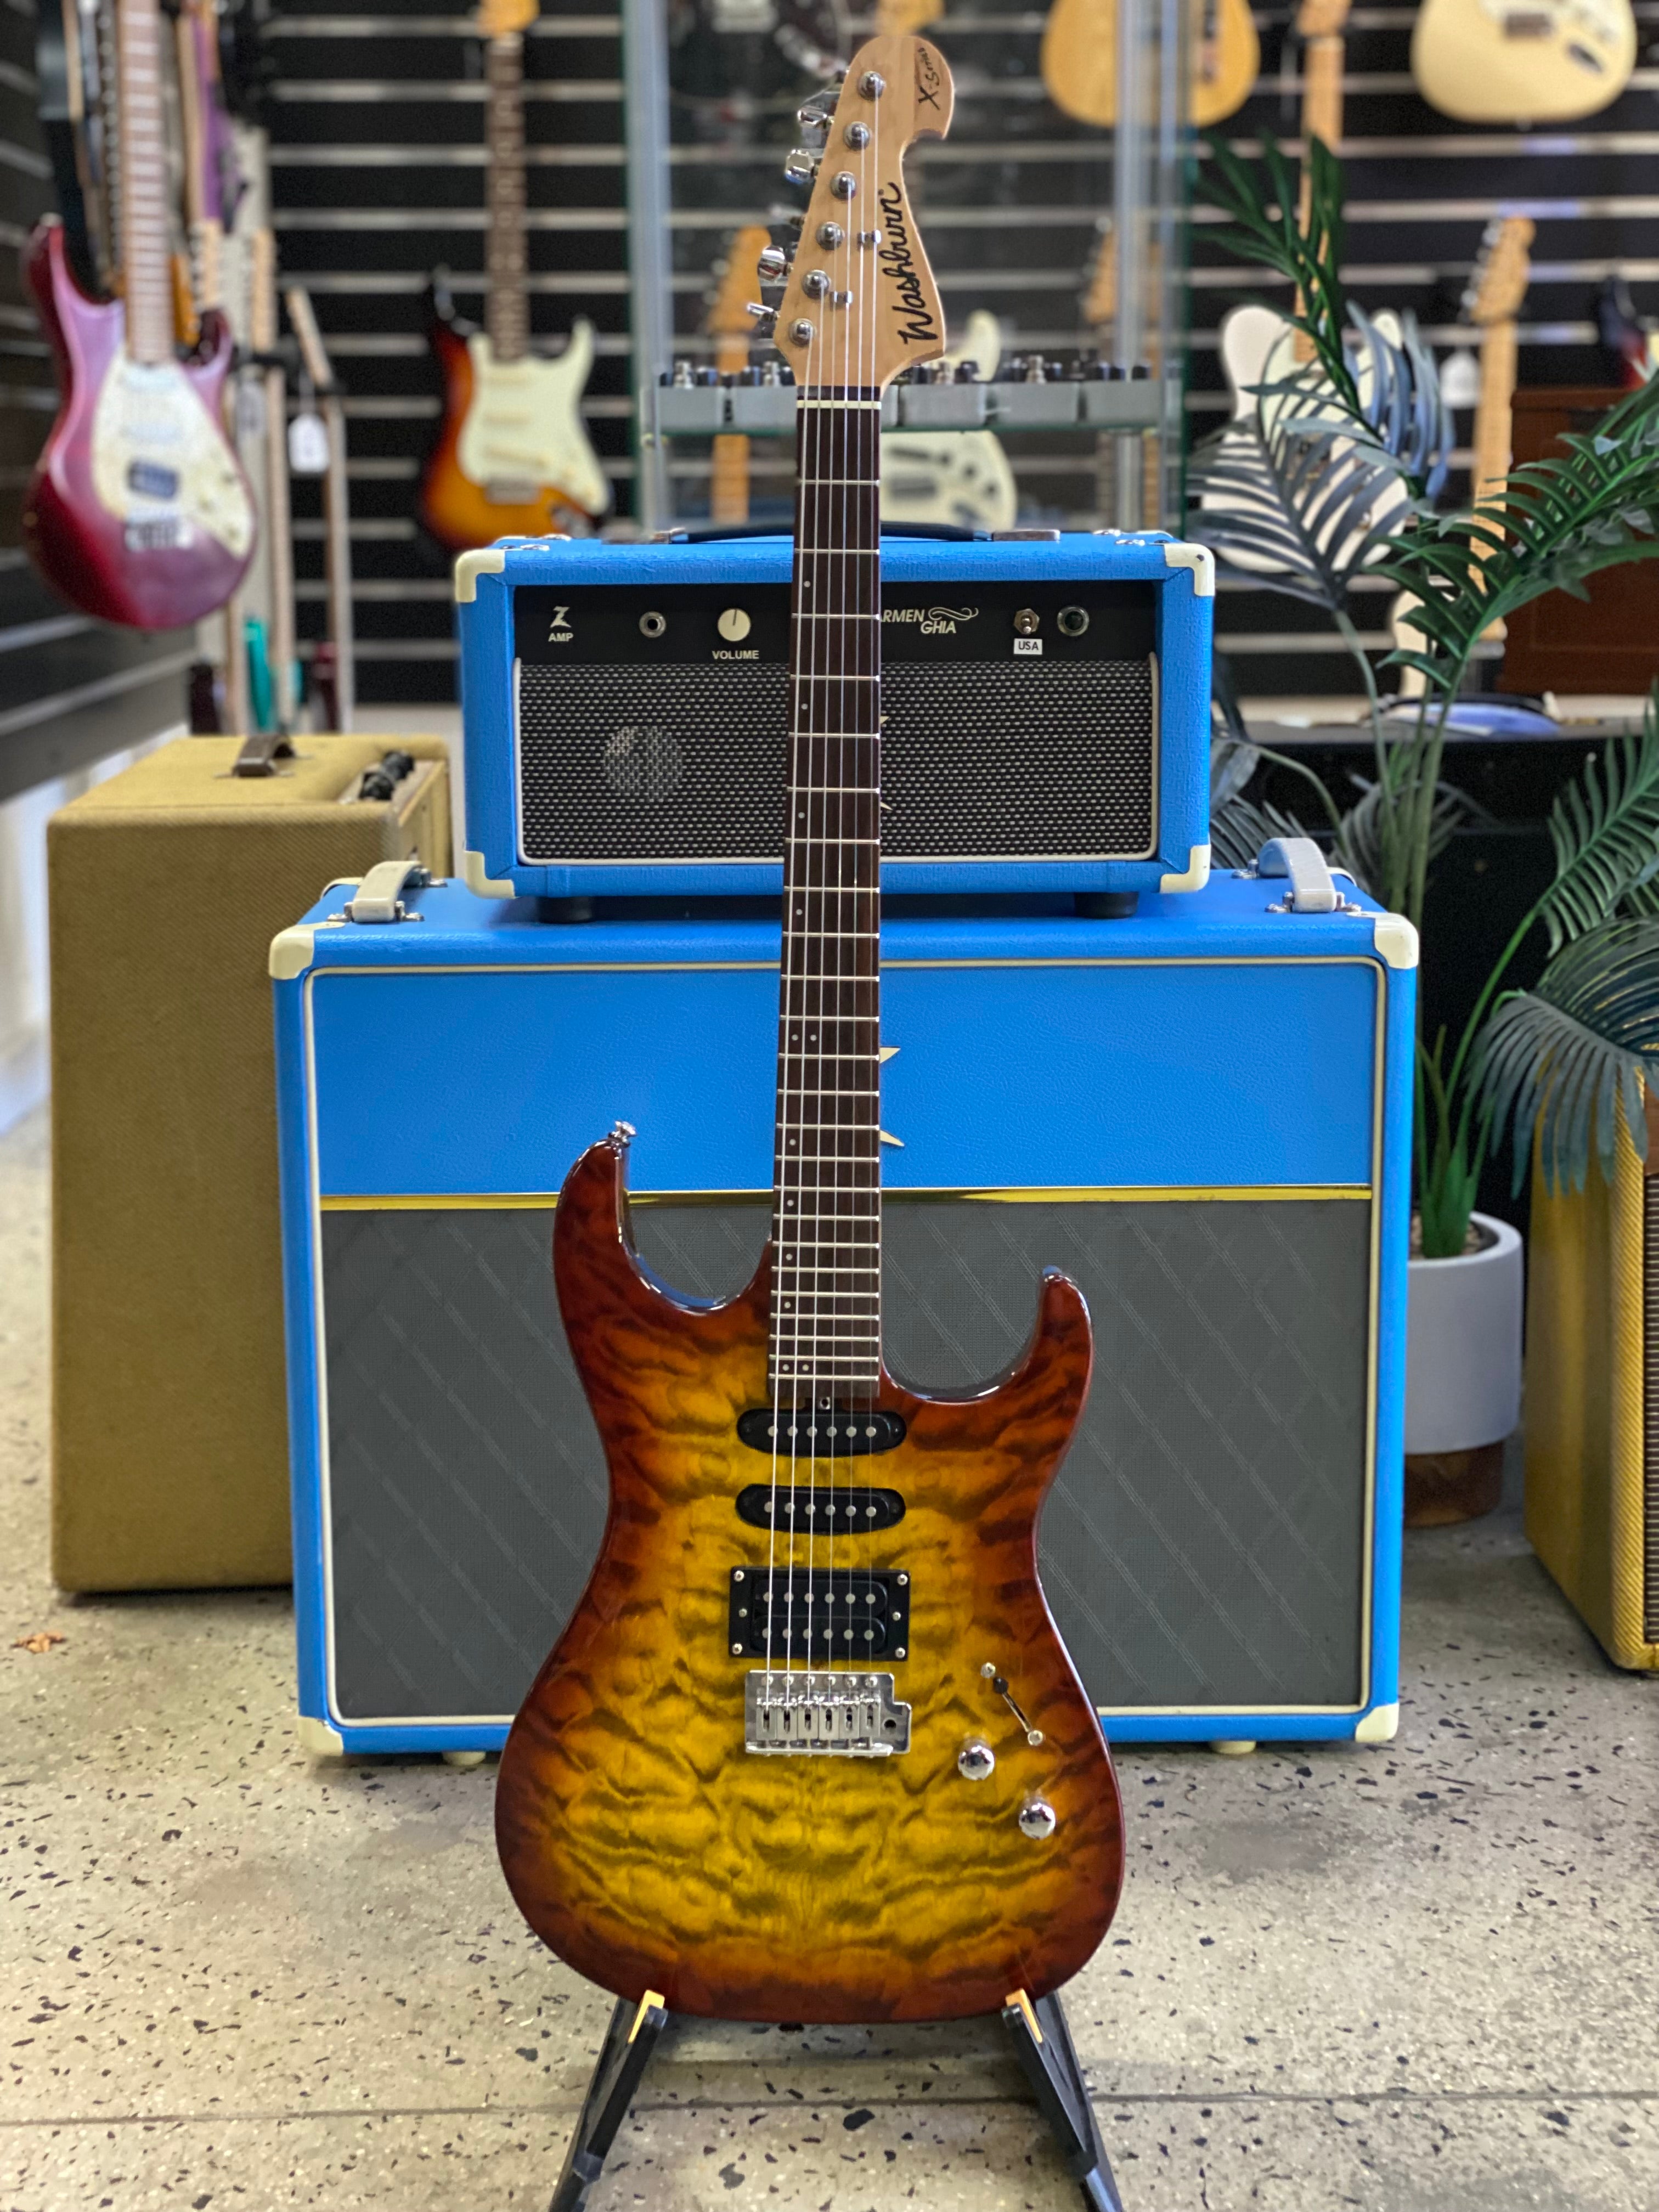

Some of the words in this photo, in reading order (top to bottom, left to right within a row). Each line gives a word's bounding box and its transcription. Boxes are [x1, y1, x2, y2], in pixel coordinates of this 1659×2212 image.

[878, 182, 938, 345] Washburn
[880, 609, 925, 623] RMEN
[921, 620, 956, 634] GHIA
[548, 633, 574, 642] AMP
[1018, 641, 1039, 650] USA
[712, 650, 760, 659] VOLUME
